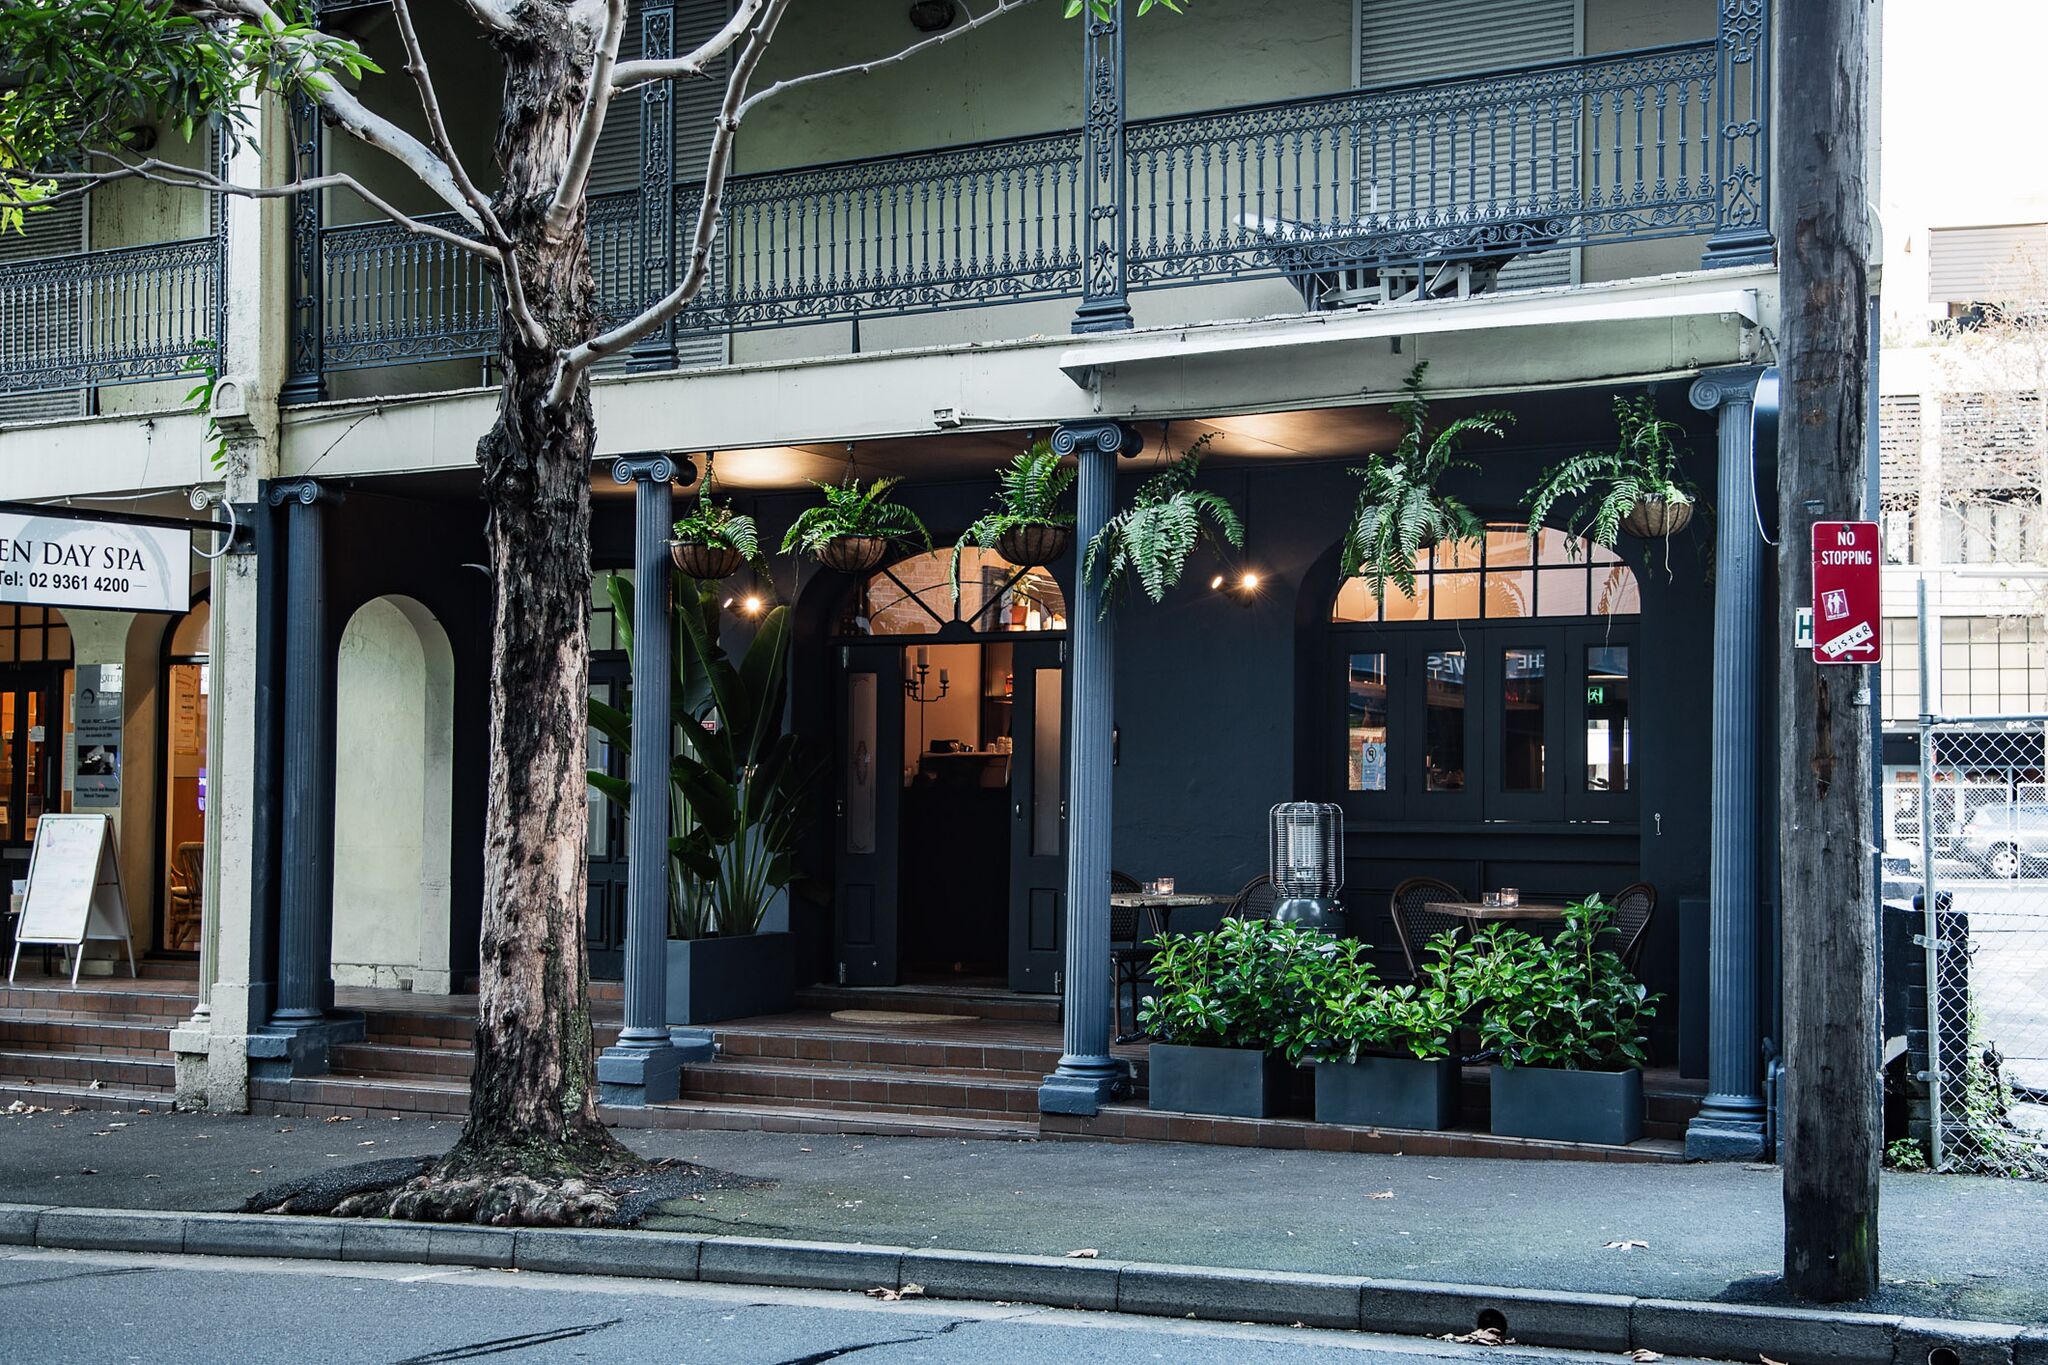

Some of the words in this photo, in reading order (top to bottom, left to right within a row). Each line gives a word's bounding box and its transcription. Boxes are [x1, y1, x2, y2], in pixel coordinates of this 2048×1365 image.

[1837, 531, 1855, 546] NO
[0, 538, 32, 563] EN
[43, 541, 96, 568] DAY
[103, 547, 146, 571] SPA
[1821, 550, 1872, 565] STOPPING
[0, 570, 23, 586] Tel:
[29, 572, 48, 588] 02
[52, 574, 88, 590] 9361
[94, 576, 129, 593] 4200
